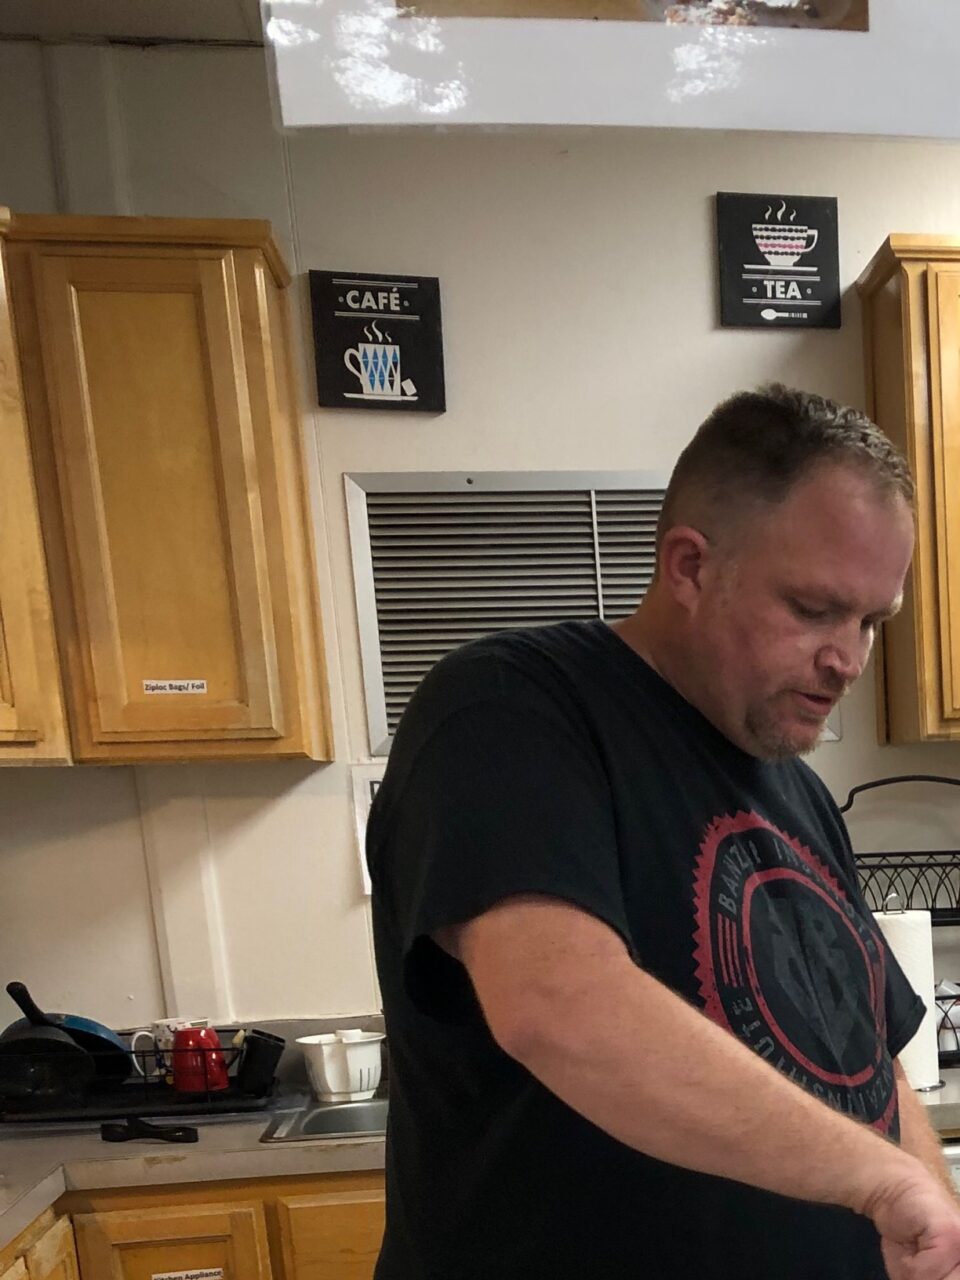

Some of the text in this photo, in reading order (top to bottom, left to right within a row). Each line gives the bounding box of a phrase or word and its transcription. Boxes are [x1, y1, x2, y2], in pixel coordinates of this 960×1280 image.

[345, 287, 401, 311] CAFÉ
[763, 280, 802, 299] TEA
[144, 684, 167, 692] Ziploc
